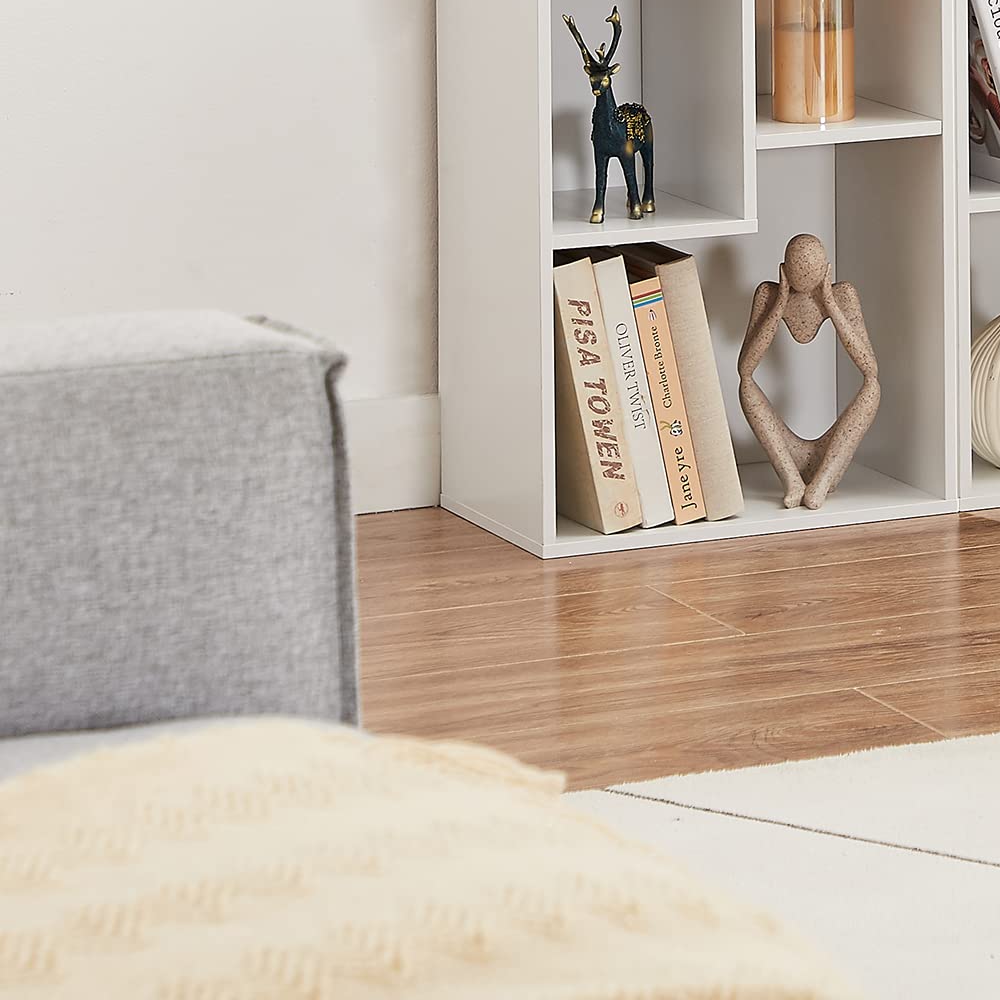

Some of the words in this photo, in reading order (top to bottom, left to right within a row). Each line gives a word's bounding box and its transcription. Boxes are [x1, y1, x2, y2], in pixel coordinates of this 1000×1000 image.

[567, 299, 601, 367] PISA
[650, 325, 664, 360] Bronte
[615, 322, 637, 381] OLIVER
[626, 381, 647, 430] TWIST
[656, 360, 673, 409] Charlotte
[583, 377, 626, 480] TOWEN
[675, 446, 692, 473] yre
[681, 475, 698, 510] Jane
